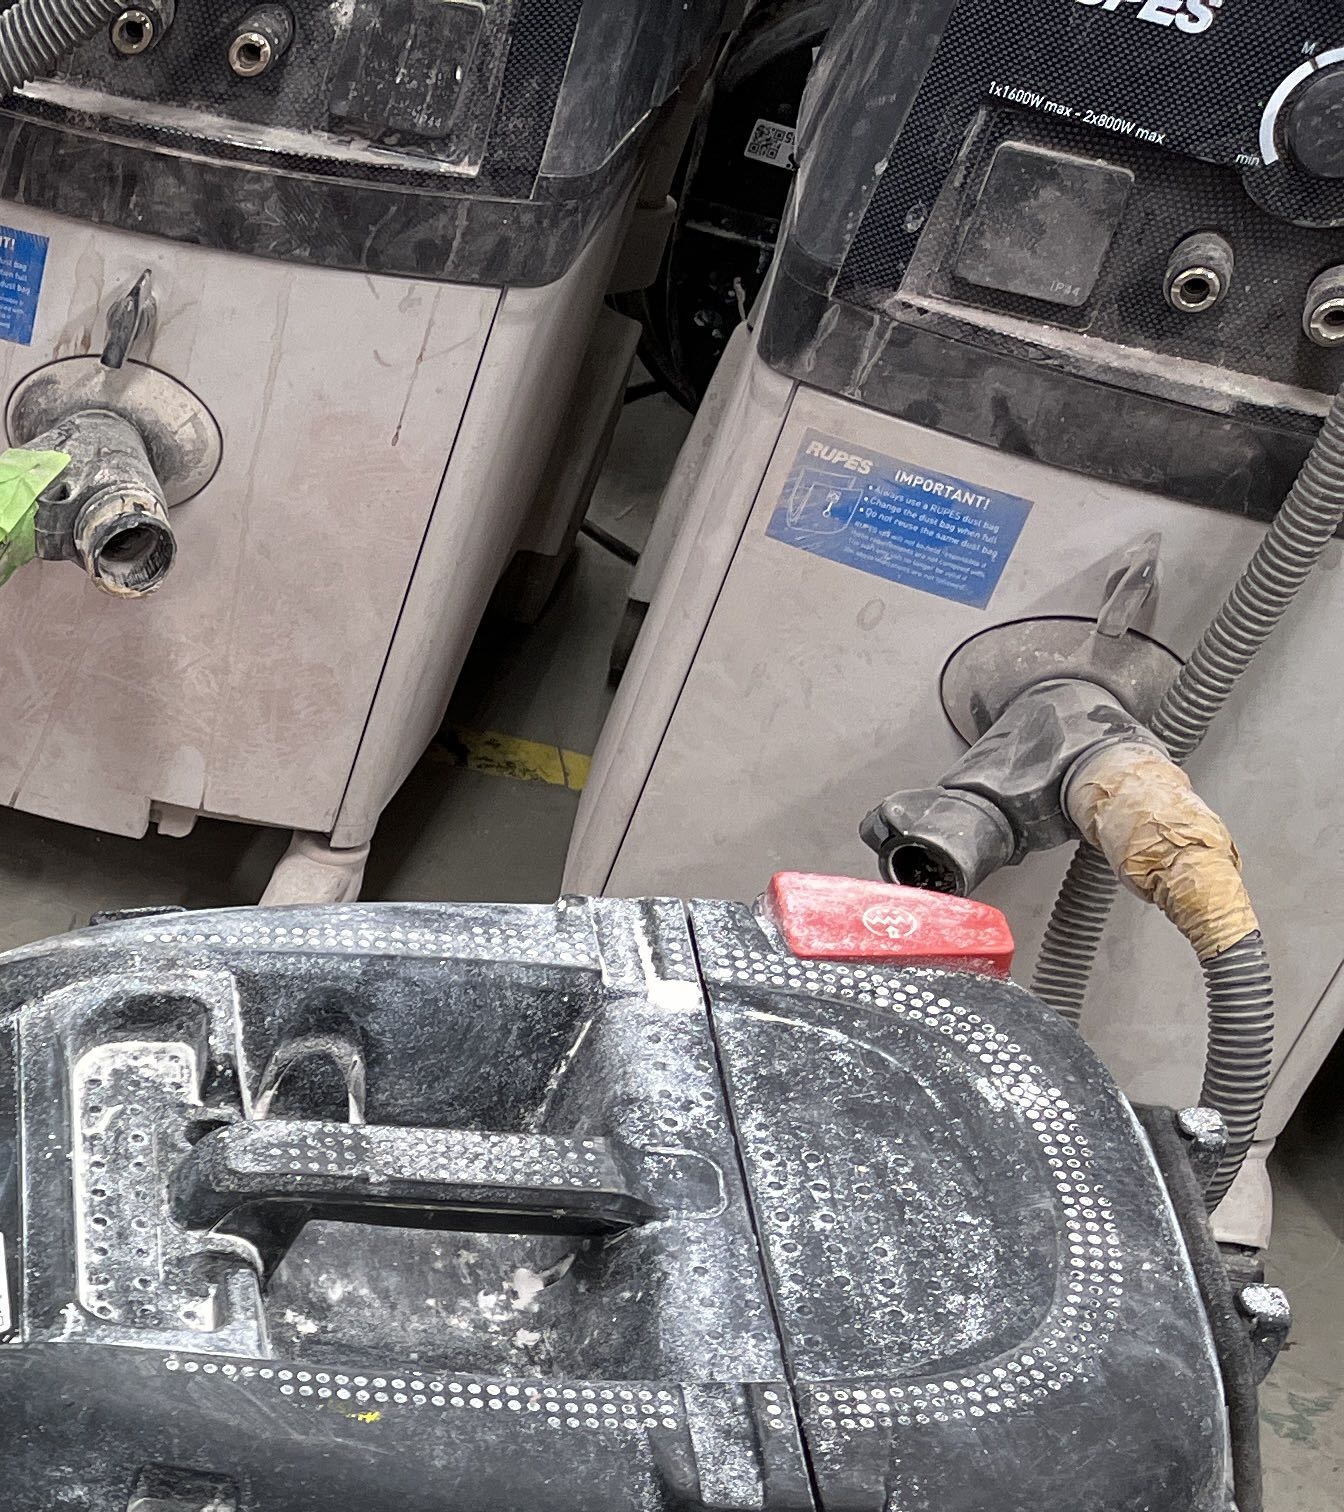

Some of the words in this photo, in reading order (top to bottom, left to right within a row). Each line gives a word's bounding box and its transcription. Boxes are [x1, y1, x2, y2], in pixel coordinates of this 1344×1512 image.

[1301, 41, 1317, 55] M
[988, 81, 1044, 109] 1x1600W
[1044, 99, 1072, 118] max
[1085, 109, 1135, 135] 2x800W
[1135, 127, 1166, 145] max
[1235, 153, 1261, 166] min
[805, 440, 874, 475] RUPES
[873, 485, 905, 503] Always
[904, 497, 921, 507] use
[929, 503, 961, 521] RUPES
[961, 514, 982, 527] dust
[981, 521, 1000, 533] bag
[895, 469, 992, 511] IMPORTANT!
[868, 496, 903, 515] Change
[902, 507, 918, 519] the
[917, 513, 938, 525] dust
[937, 519, 956, 532] bag
[955, 525, 981, 539] when
[981, 532, 998, 544] full
[877, 512, 893, 523] not
[893, 518, 919, 532] reuse
[919, 526, 935, 536] the
[934, 532, 960, 545] same
[959, 539, 980, 552] dust
[980, 546, 998, 559] bag
